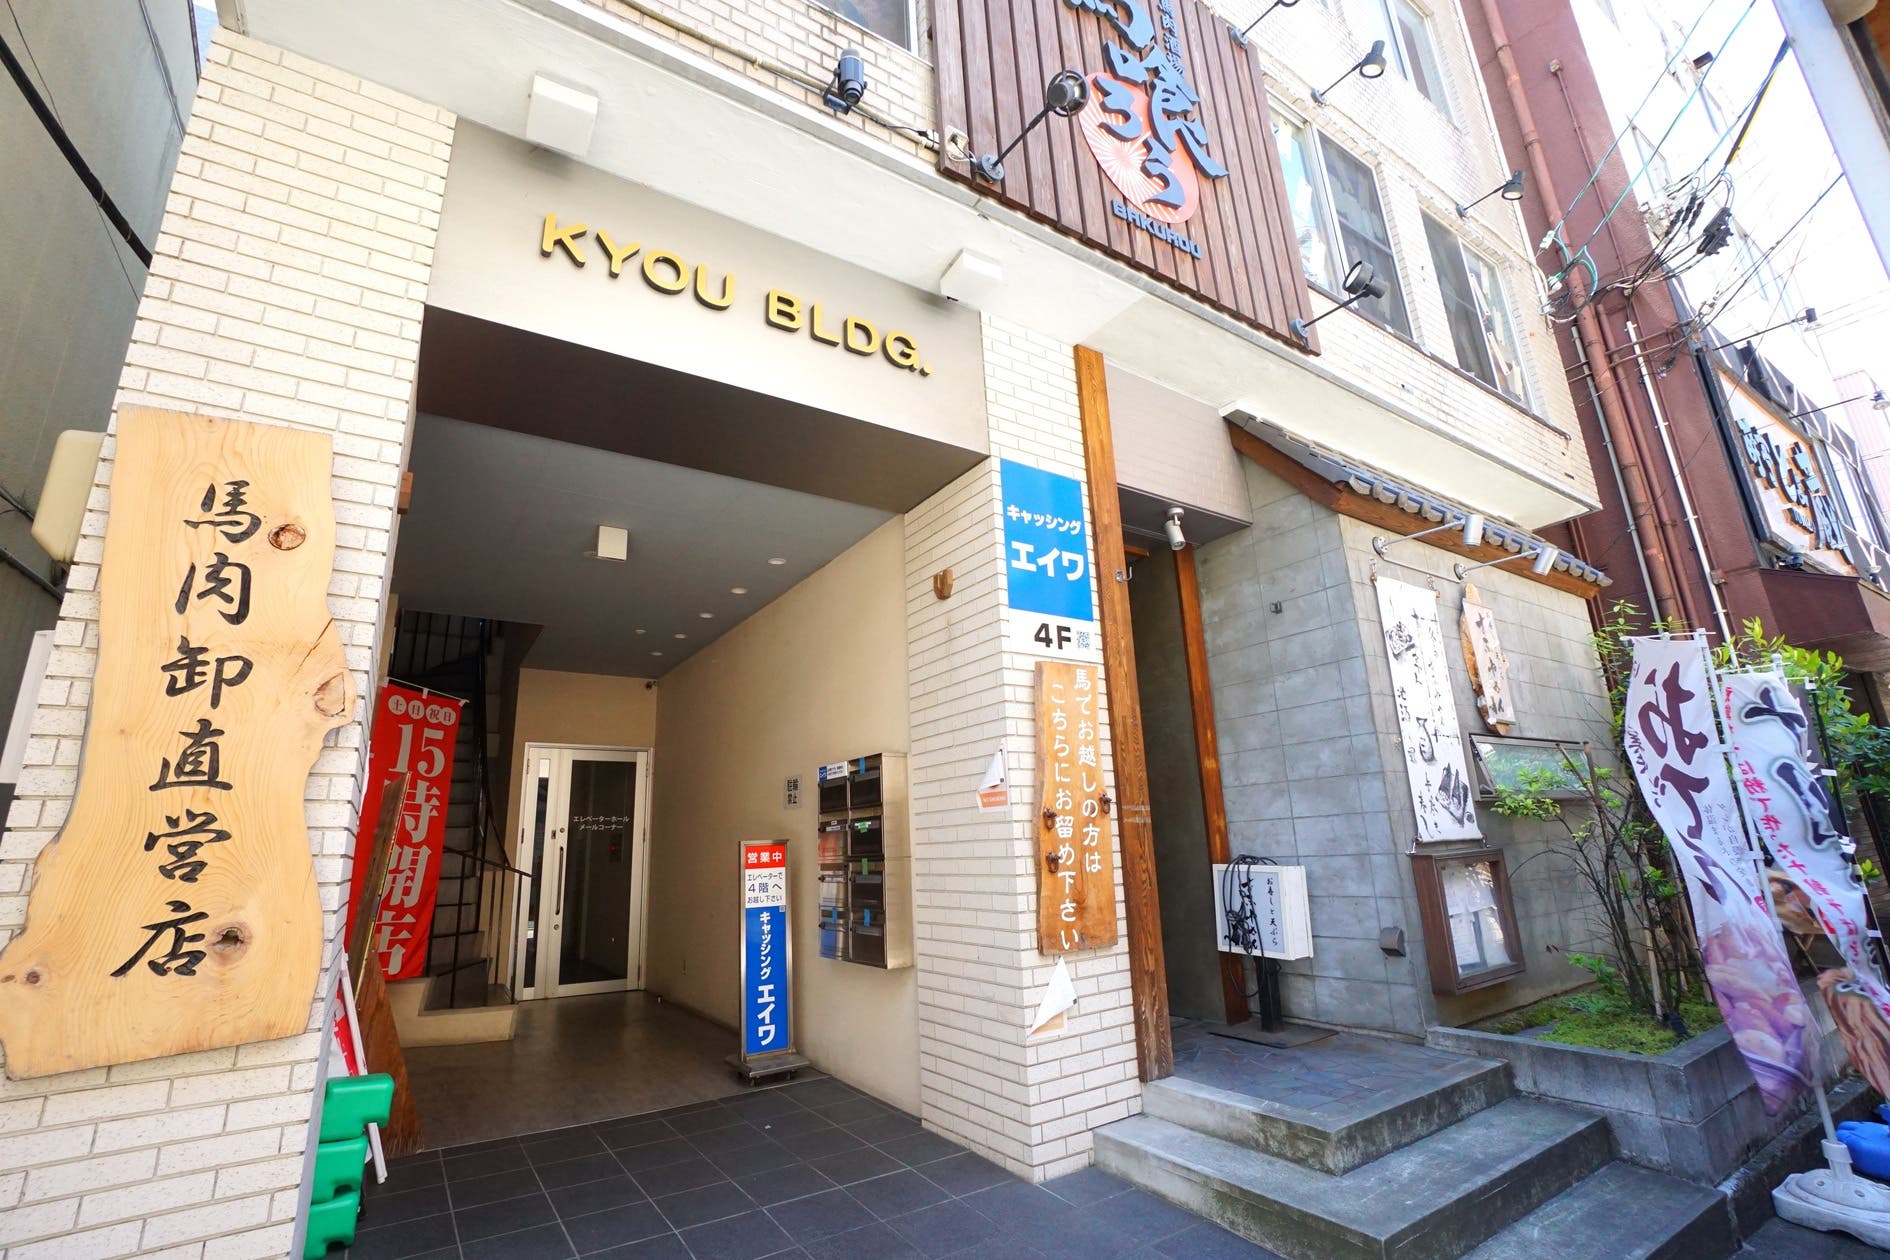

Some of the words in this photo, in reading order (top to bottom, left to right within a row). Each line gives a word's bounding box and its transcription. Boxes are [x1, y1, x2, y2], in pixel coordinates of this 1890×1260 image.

[1111, 200, 1201, 259] BAKUROU
[541, 212, 735, 310] KYOU
[765, 288, 932, 377] BLDG.
[1007, 504, 1081, 535] キャッシング
[1011, 540, 1085, 581] エイワ
[1034, 622, 1071, 650] 4F
[111, 480, 262, 977] 馬肉卸直営店
[1051, 683, 1079, 950] こちらにお留め下さい
[747, 851, 783, 864] 営業中
[747, 871, 783, 882] エレベーターで
[747, 894, 783, 904] お越し下さい
[760, 911, 772, 980] キャッシング
[757, 984, 776, 1046] エイワ
